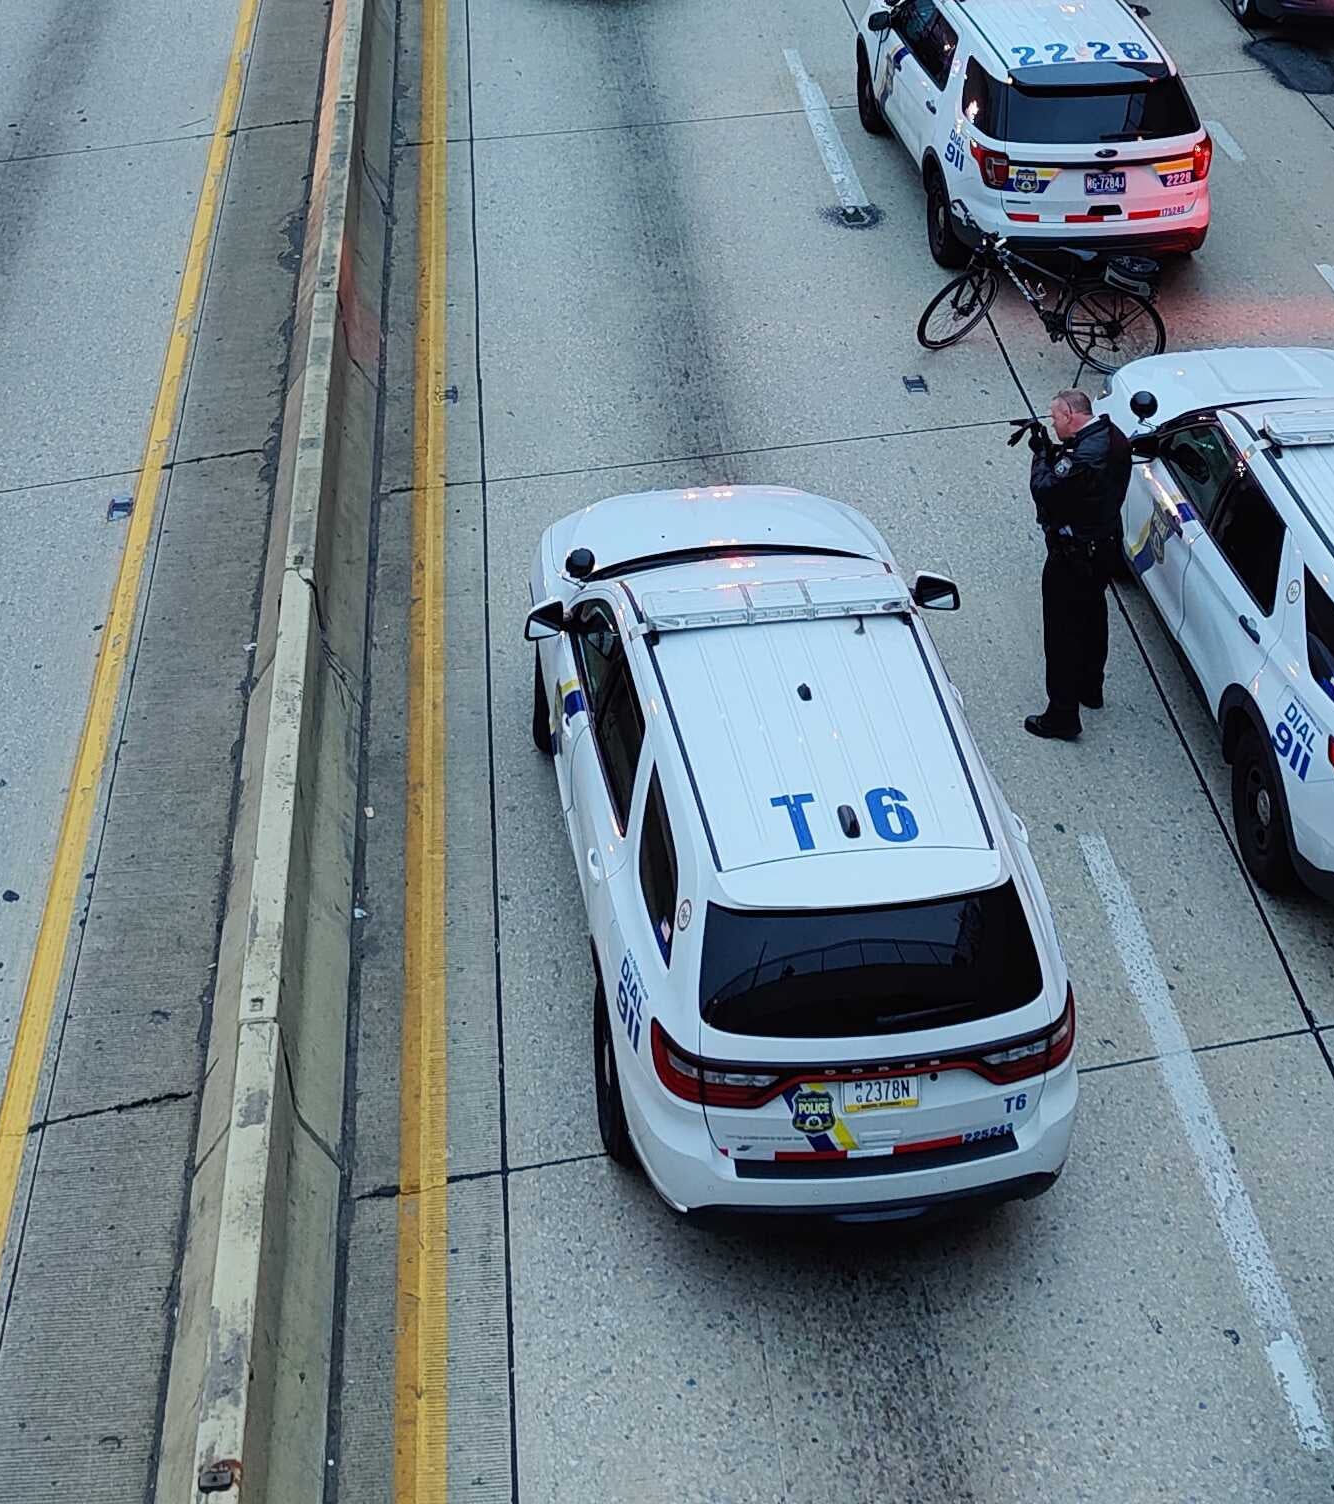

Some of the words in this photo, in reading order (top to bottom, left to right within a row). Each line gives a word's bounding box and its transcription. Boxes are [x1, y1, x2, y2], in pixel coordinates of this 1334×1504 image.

[949, 127, 965, 147] DIAL
[944, 142, 965, 173] 911
[1167, 170, 1192, 186] 2228
[1284, 702, 1316, 754] DIAL
[1271, 721, 1311, 783] 911
[620, 956, 643, 1022] DIAL
[616, 980, 641, 1055] 911
[865, 1079, 911, 1103] 2378N
[798, 1102, 830, 1115] POLICE
[1004, 1093, 1027, 1114] T6
[961, 1122, 1015, 1143] 225243
